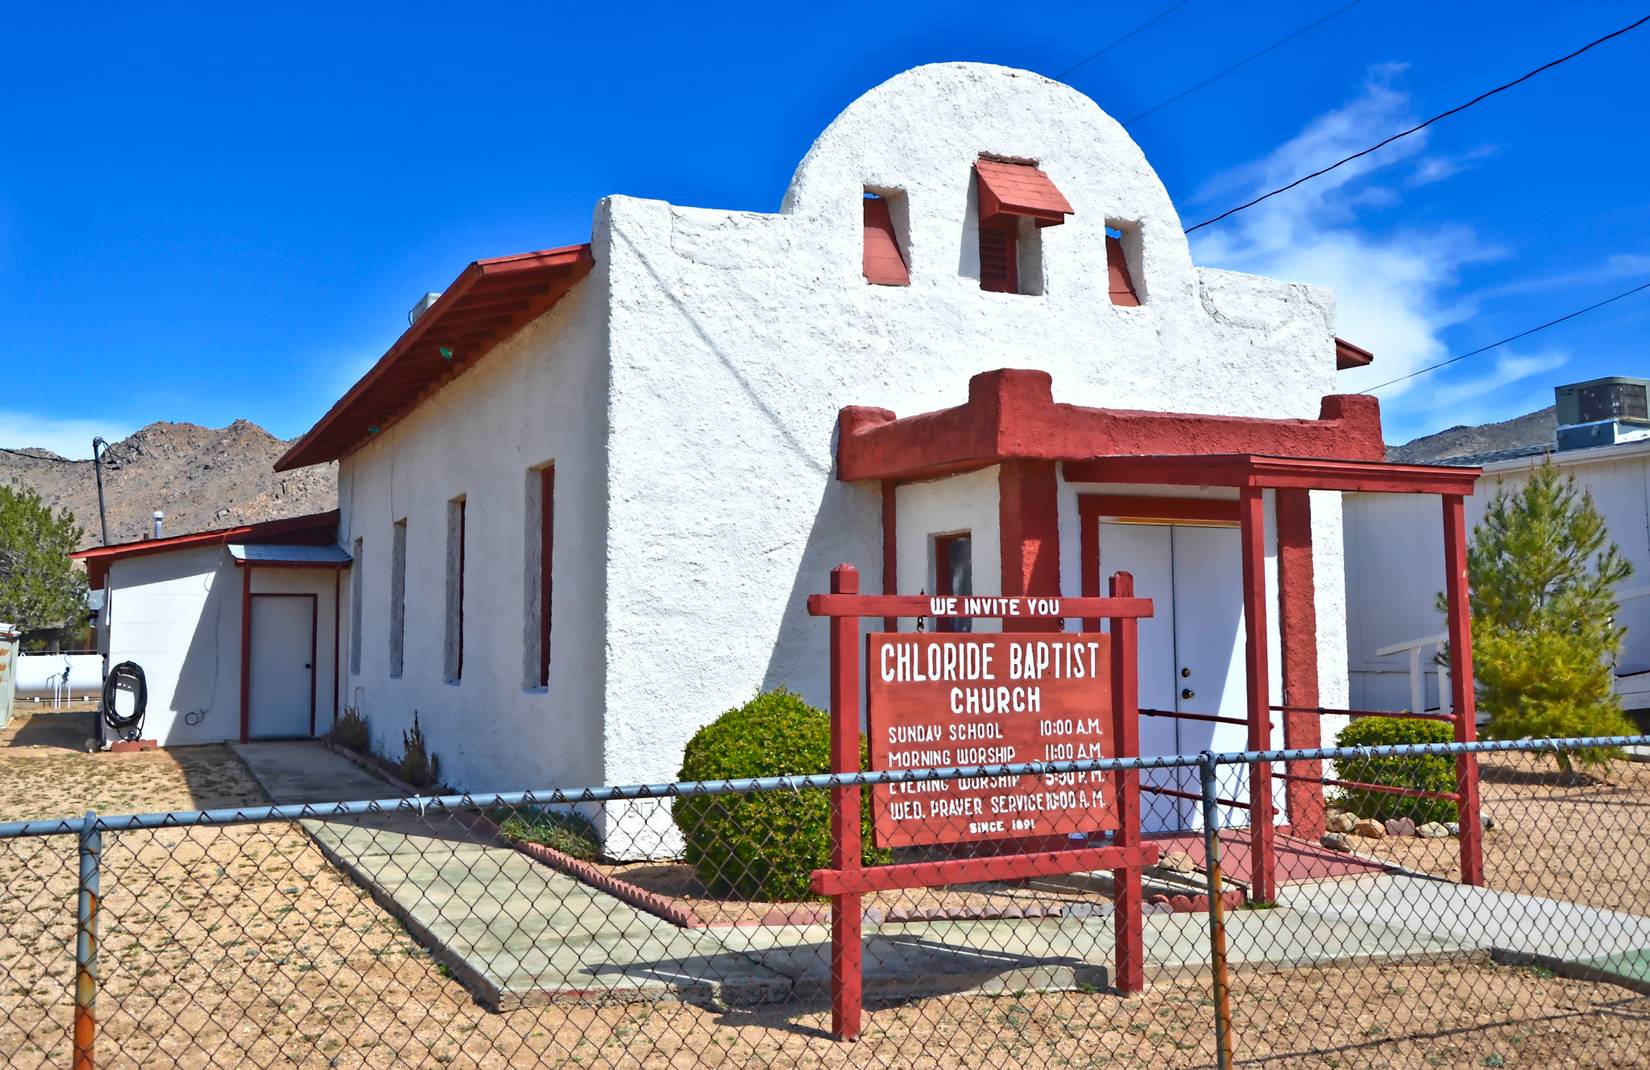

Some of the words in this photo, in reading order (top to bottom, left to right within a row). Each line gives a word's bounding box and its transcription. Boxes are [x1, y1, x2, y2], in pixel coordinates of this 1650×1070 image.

[931, 598, 957, 615] WE
[965, 599, 1019, 615] INVITE
[1028, 599, 1059, 615] YOU
[881, 643, 994, 682] CHLORIDE
[1010, 642, 1098, 679] BAPTIST
[951, 687, 1040, 714] CHURCH
[889, 725, 941, 743] SUNDAY
[949, 723, 1003, 740] SCHOOL
[1041, 720, 1072, 736] 10:00
[1076, 718, 1102, 734] A.M.
[889, 750, 950, 768] MORNING
[957, 746, 1015, 765] WORSHIP
[1046, 743, 1073, 760] 11:00
[1077, 743, 1104, 759] A.M.
[891, 801, 926, 820] WED.
[931, 798, 982, 817] PRAYER
[991, 793, 1044, 813] SERVICE
[970, 821, 1004, 833] SINCE
